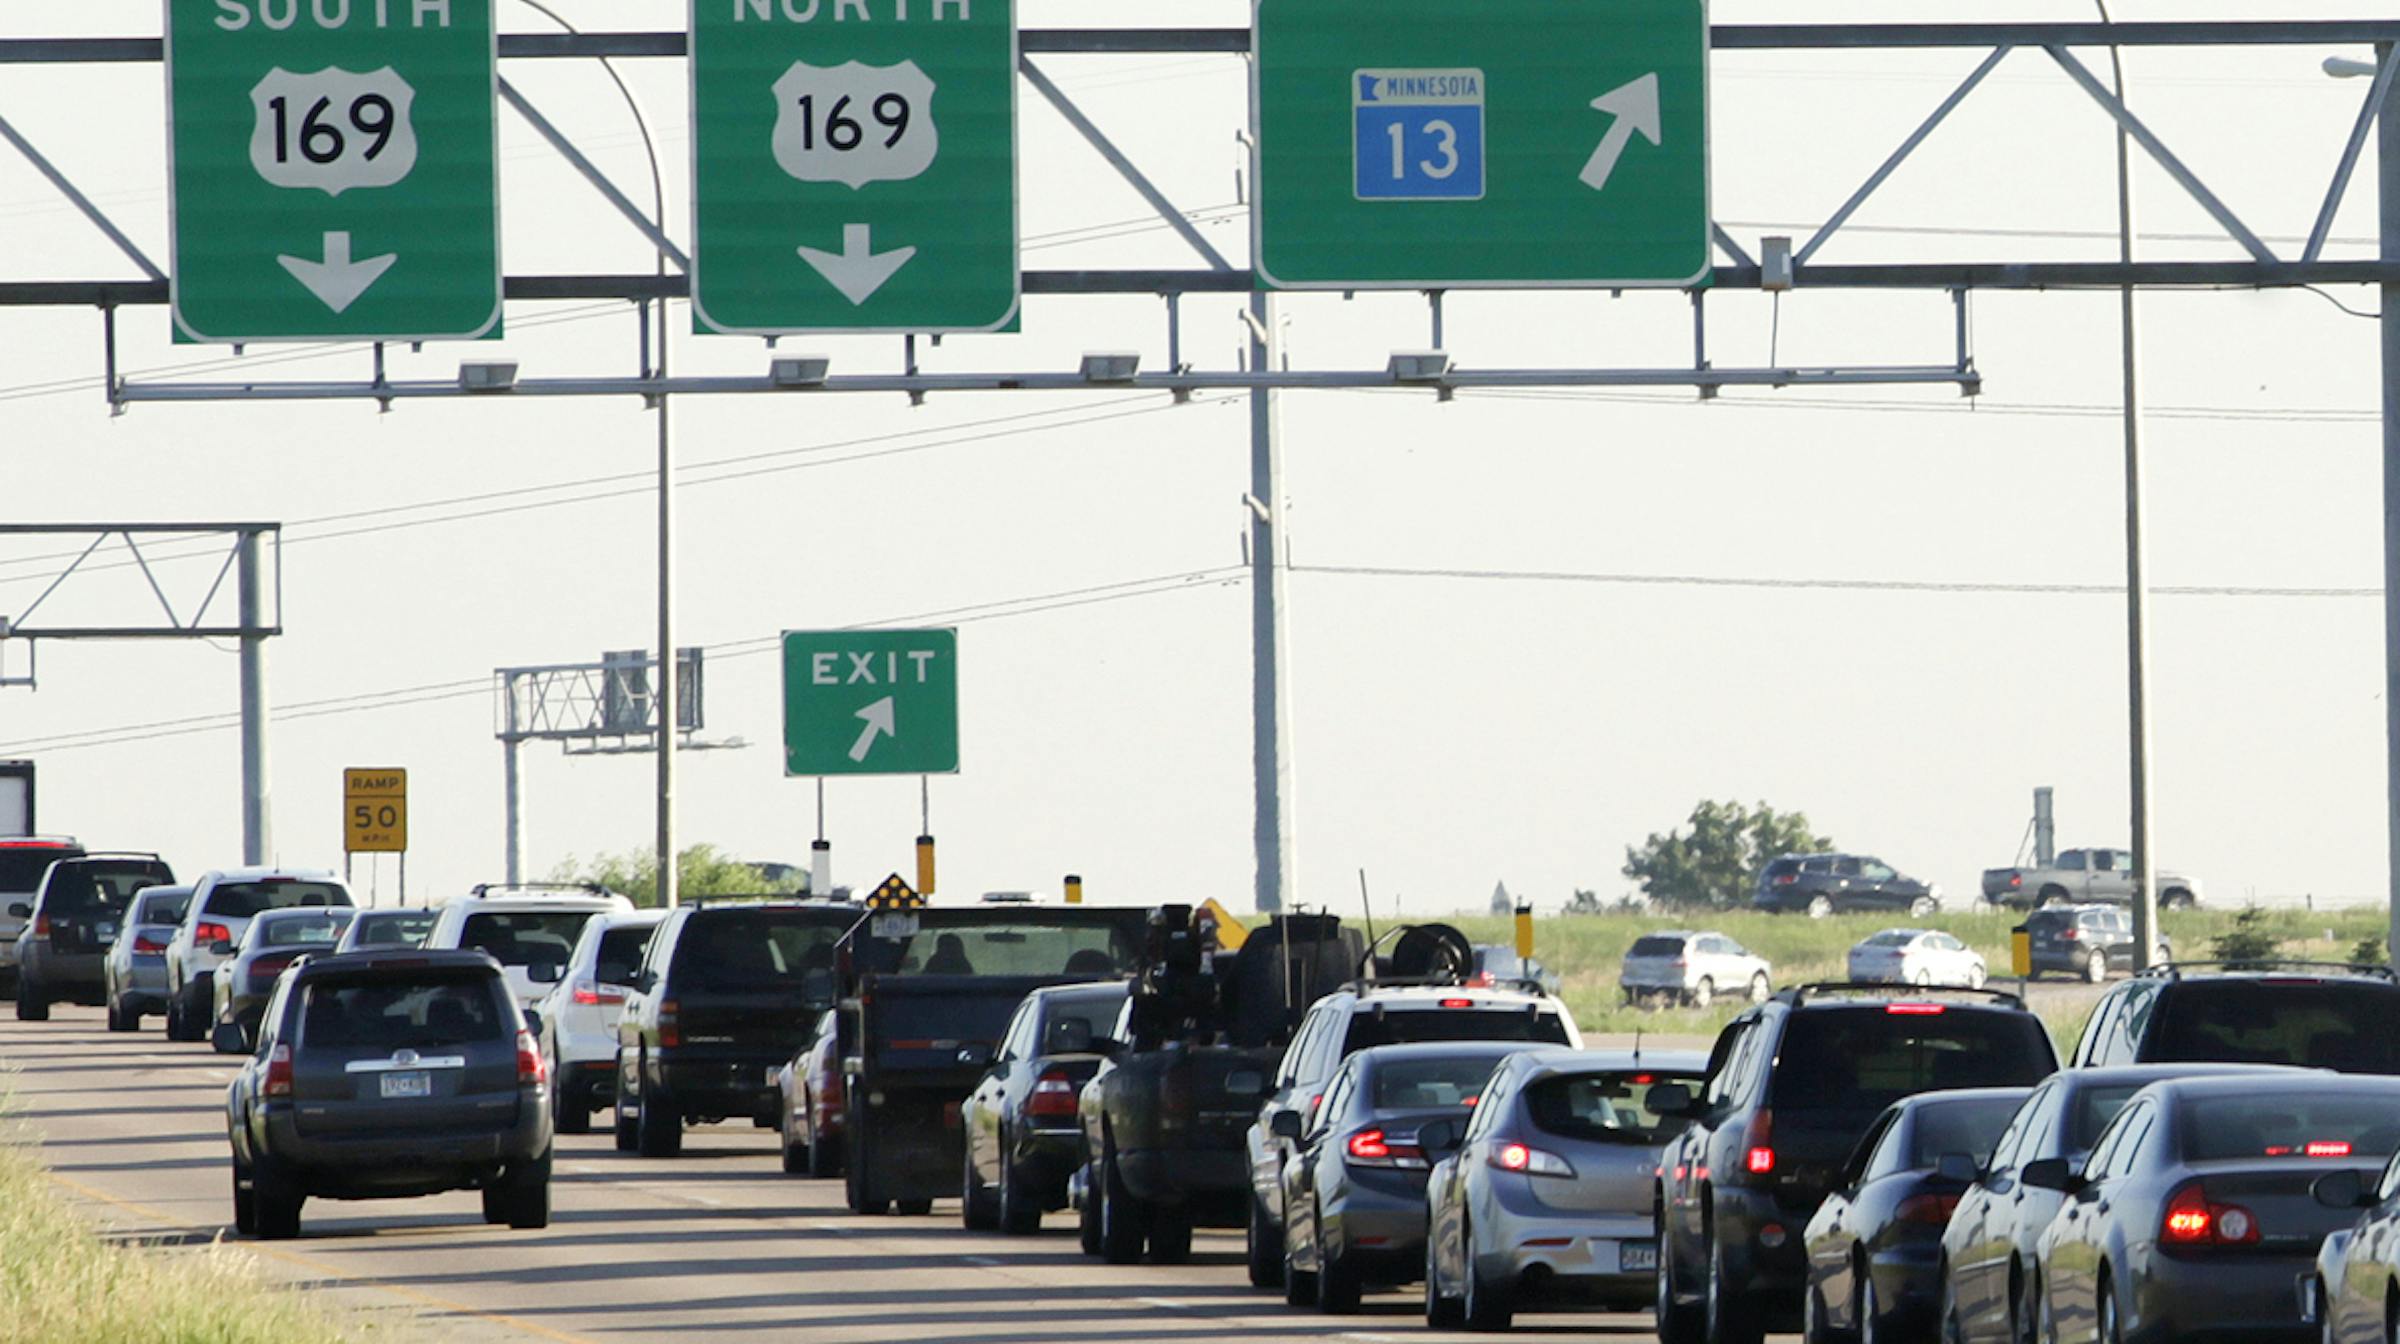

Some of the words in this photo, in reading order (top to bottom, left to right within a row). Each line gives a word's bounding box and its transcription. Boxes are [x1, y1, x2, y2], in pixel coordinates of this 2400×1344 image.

[214, 0, 450, 30] SOUTH
[1386, 75, 1478, 97] MINNESOTA
[269, 92, 395, 164] 169
[797, 92, 911, 152] 169
[1386, 118, 1459, 180] 13
[811, 650, 936, 685] EXIT
[352, 777, 399, 789] RAMP
[355, 805, 396, 828] 50
